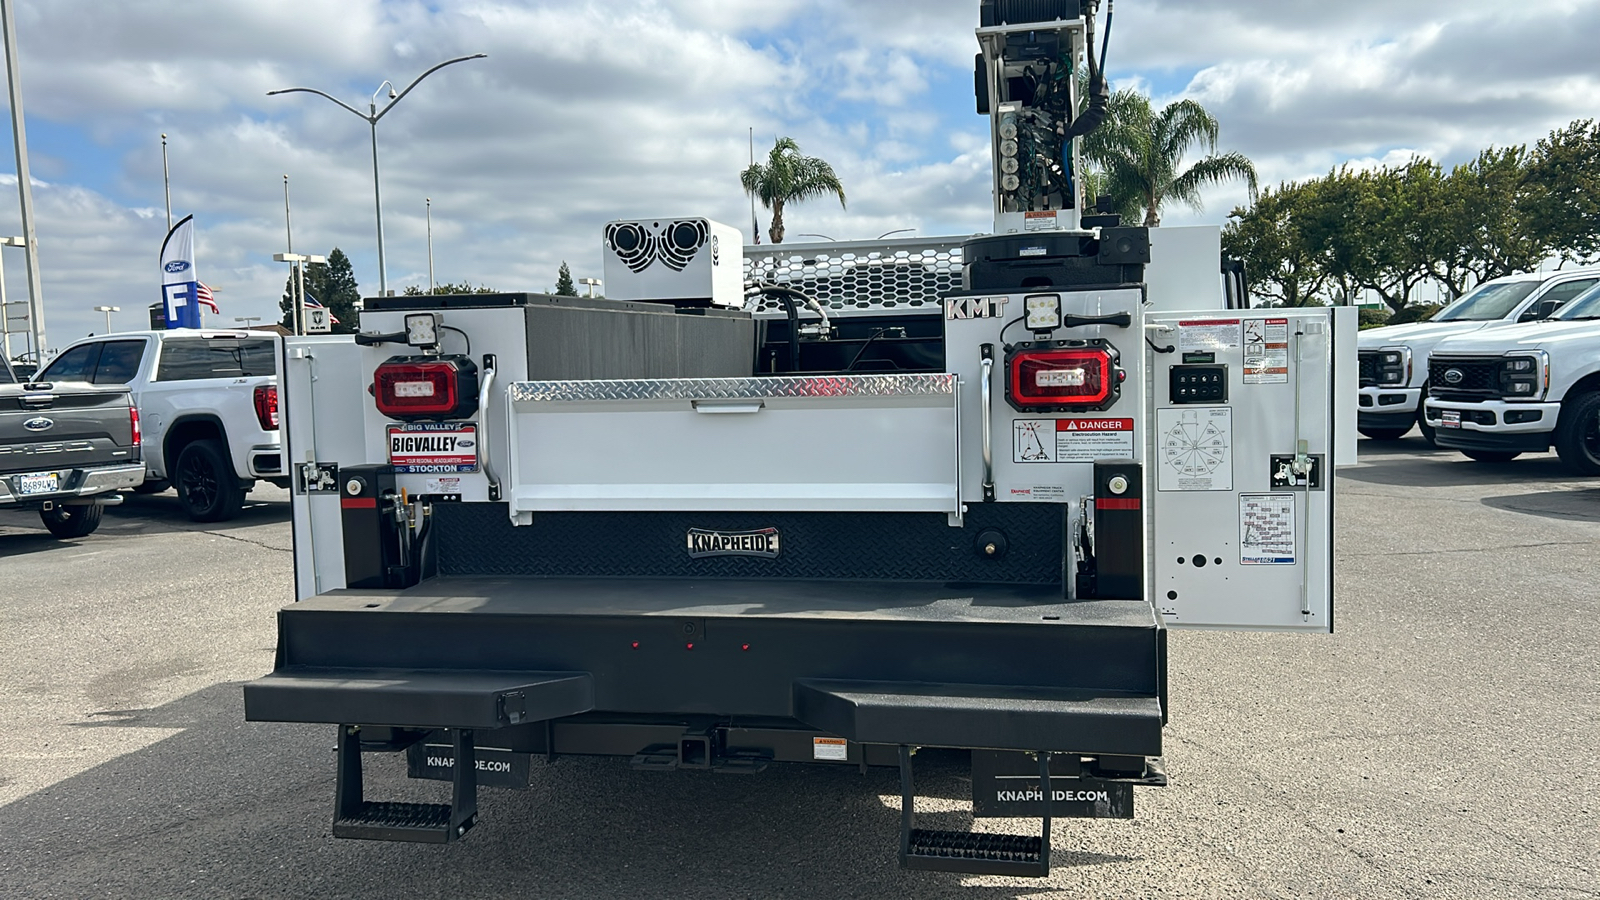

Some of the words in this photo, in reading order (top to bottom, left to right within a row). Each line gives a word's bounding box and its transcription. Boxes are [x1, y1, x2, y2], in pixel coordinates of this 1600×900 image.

[166, 262, 187, 272] Ford
[166, 284, 188, 322] F
[946, 296, 1009, 320] KMT
[392, 437, 457, 452] BIGVALLEY
[692, 532, 774, 554] KNAPHEIDE
[427, 756, 510, 772] KNAPE.COM
[997, 790, 1108, 802] KNAPHIDE.COM
